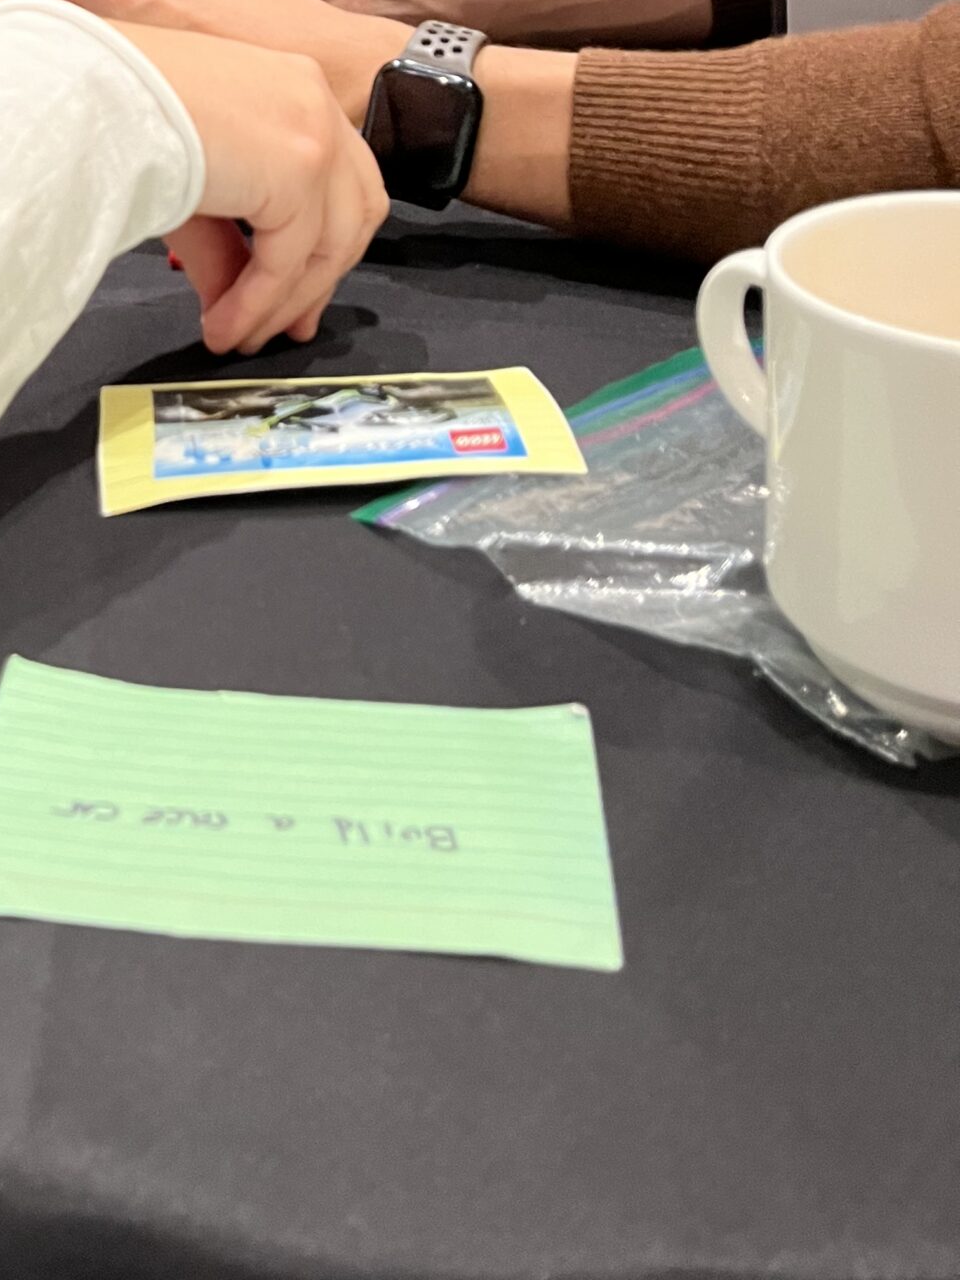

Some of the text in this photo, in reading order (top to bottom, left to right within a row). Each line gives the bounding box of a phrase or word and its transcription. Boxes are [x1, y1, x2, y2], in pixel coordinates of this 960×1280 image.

[50, 800, 459, 852] Build a race car
